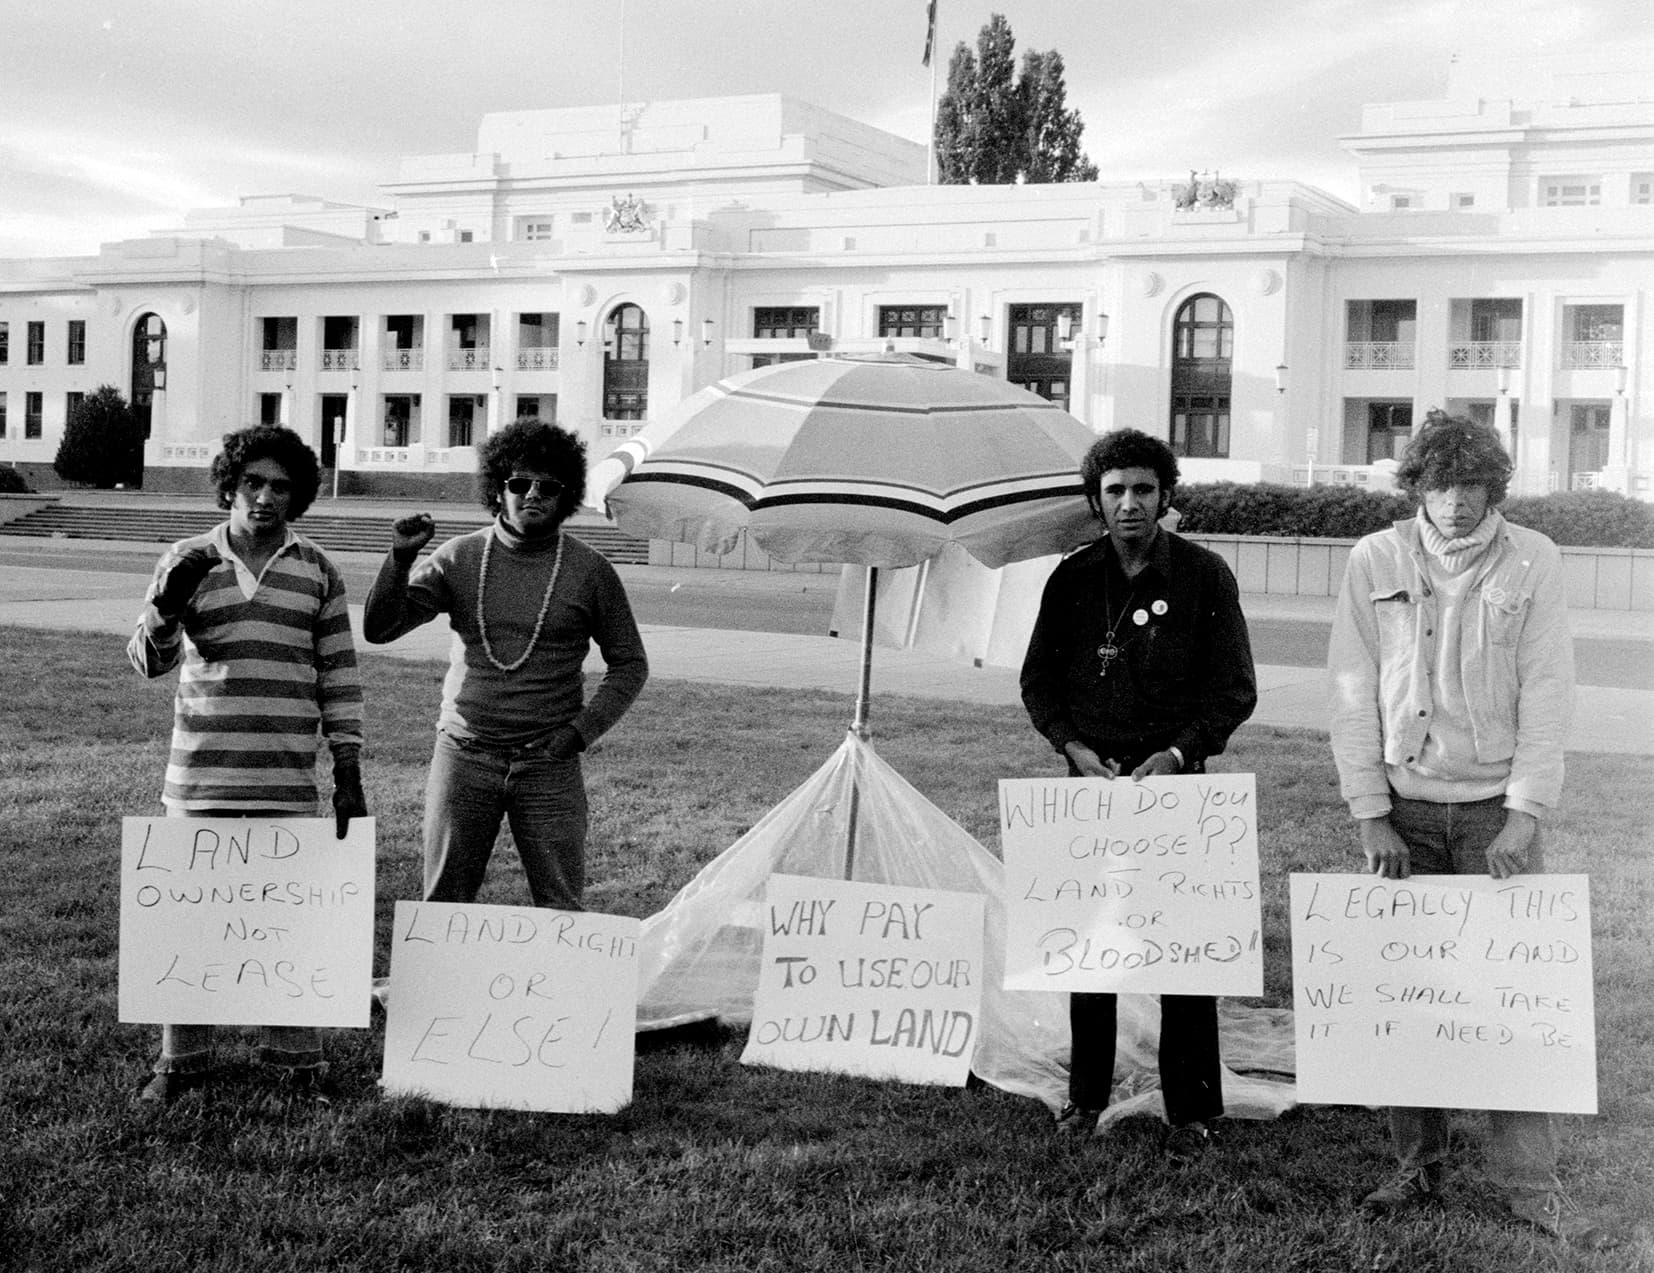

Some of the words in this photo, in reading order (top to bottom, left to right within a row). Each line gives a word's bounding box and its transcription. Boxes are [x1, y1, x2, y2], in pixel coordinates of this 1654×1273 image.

[1004, 786, 1113, 830] WHICH
[1133, 784, 1180, 815] DO
[1197, 785, 1249, 825] YOU
[136, 823, 300, 873] LAND
[136, 881, 360, 908] OWNERSHIP
[1023, 868, 1143, 902] LAND
[1158, 871, 1255, 900] RIGHTS
[770, 899, 837, 936] WHY
[859, 901, 935, 940] PAY
[1305, 882, 1472, 937] LEGALLY
[1497, 885, 1578, 922] THIS
[223, 917, 289, 941] NOT
[404, 908, 538, 945] LAND
[551, 914, 637, 958] RIGHT
[1308, 940, 1344, 965] IS
[1381, 941, 1459, 962] OUR
[1485, 938, 1580, 964] LAND
[155, 954, 335, 999] LEASE
[488, 972, 553, 1000] OR
[775, 956, 817, 989] TO
[1304, 983, 1353, 1009] WE
[1375, 983, 1471, 1005] SHALL
[1495, 986, 1572, 1012] TAKE
[756, 1012, 855, 1045] OWN
[870, 1008, 973, 1058] LAND
[1309, 1022, 1338, 1039] IT
[1375, 1021, 1400, 1036] IF
[1436, 1020, 1513, 1045] NEED
